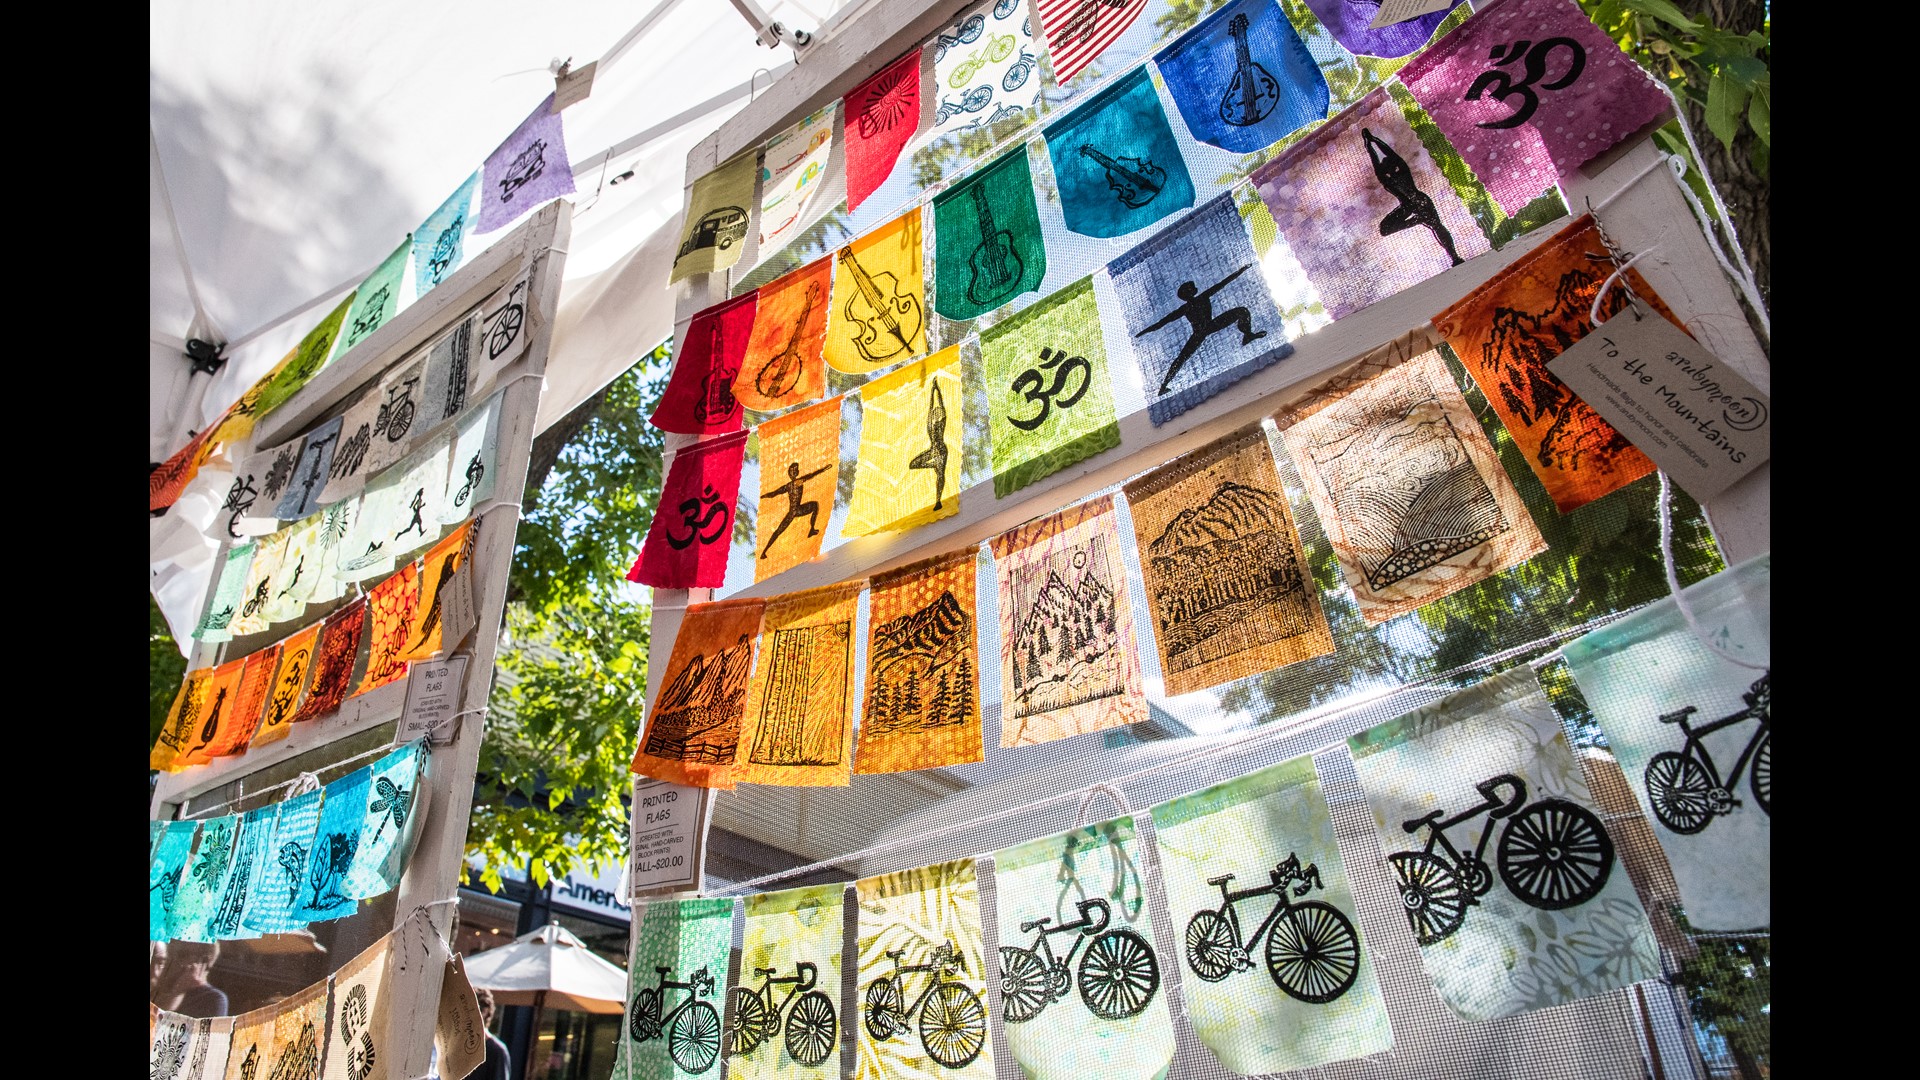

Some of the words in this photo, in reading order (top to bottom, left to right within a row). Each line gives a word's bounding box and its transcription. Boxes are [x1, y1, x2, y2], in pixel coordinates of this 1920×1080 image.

[1665, 351, 1751, 419] arubymoon
[1600, 337, 1619, 358] To
[1623, 358, 1653, 385] the
[1655, 385, 1747, 464] Mountains
[1586, 363, 1622, 395] Handmade
[1620, 390, 1638, 406] flags
[1635, 402, 1645, 413] to
[1643, 411, 1664, 429] honor
[1663, 426, 1679, 442] and
[1675, 438, 1710, 469] celebrate
[426, 682, 443, 692] FLAGS
[642, 791, 678, 808] PRINTED
[645, 809, 671, 824] FLAGS
[661, 830, 673, 838] WITH
[635, 843, 650, 851] GINAL
[651, 836, 684, 848] HAND-CARVED
[638, 850, 654, 859] BLOCK
